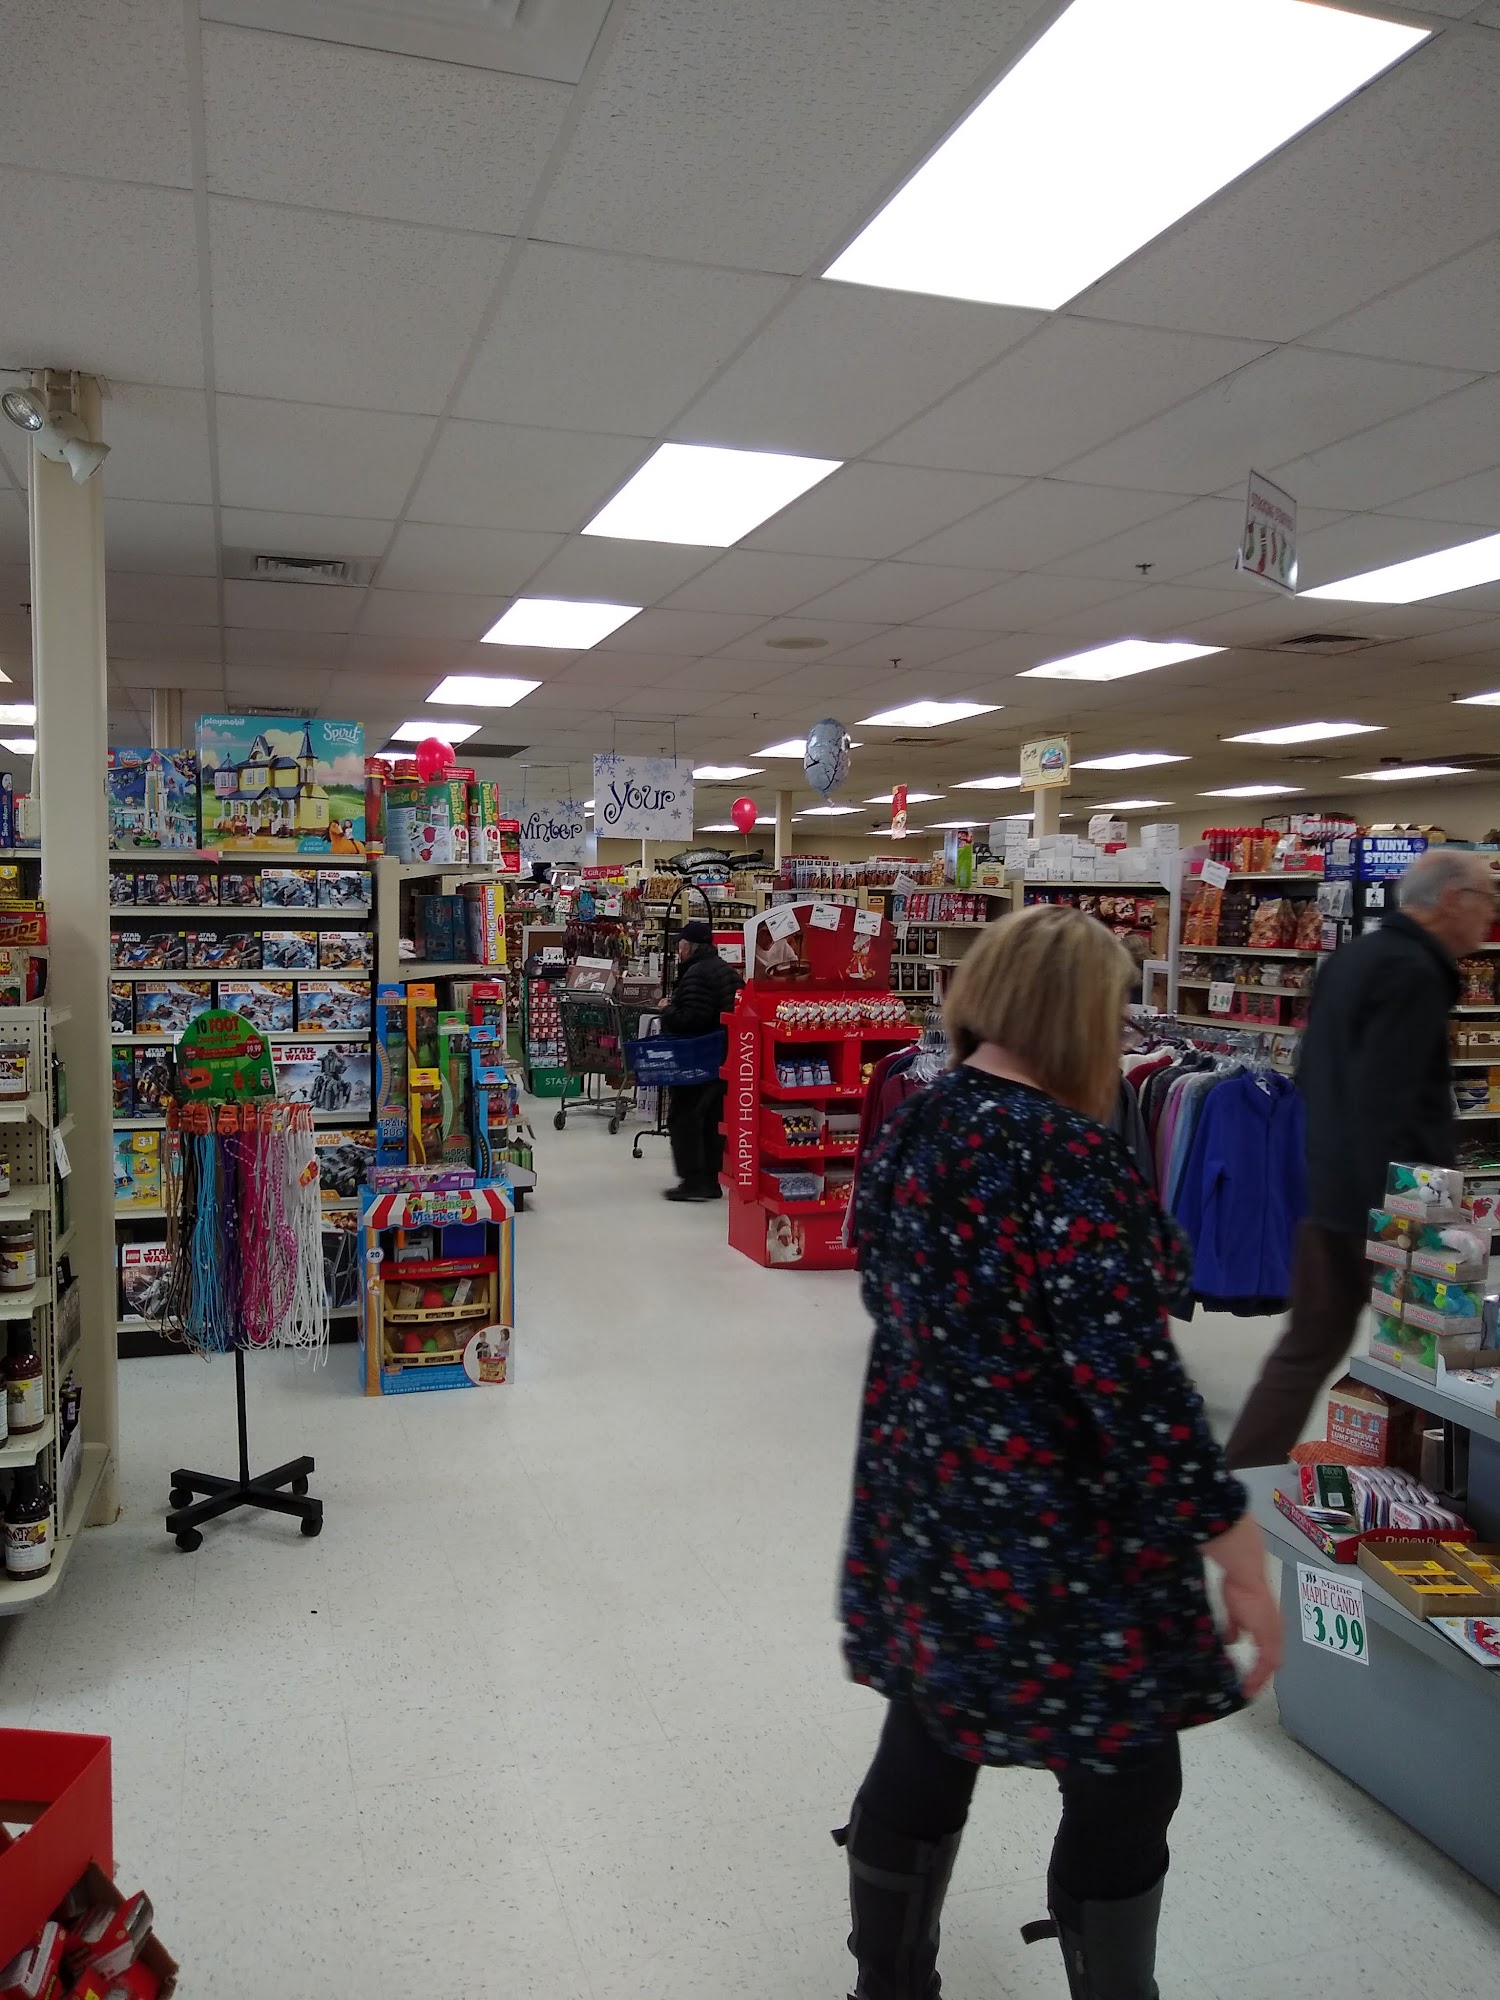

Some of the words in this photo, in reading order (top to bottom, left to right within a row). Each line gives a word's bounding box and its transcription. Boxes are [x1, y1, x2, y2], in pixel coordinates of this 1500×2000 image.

[204, 717, 245, 726] playmobil
[323, 722, 361, 744] Spirit
[450, 783, 459, 807] Pasta
[482, 783, 491, 807] Pasta
[1376, 839, 1411, 851] VINYL
[587, 868, 599, 877] Gift
[487, 888, 495, 920] Baking
[488, 922, 497, 943] Play
[489, 944, 498, 961] Set
[195, 1019, 208, 1034] 10
[209, 1016, 239, 1033] FOOT
[285, 1053, 316, 1061] WARS
[739, 1032, 754, 1120] HOLIDAYS
[377, 1118, 407, 1128] TRAIN
[383, 1128, 404, 1137] RUG
[739, 1127, 752, 1185] HAPPY
[425, 1199, 476, 1212] Farmers
[411, 1210, 461, 1223] Market
[1331, 1424, 1345, 1433] YOU
[1346, 1428, 1373, 1442] DESERVE
[1331, 1431, 1349, 1441] LUMP
[1350, 1437, 1359, 1445] OF
[1360, 1440, 1379, 1451] COAL
[1321, 1580, 1352, 1596] Maine
[1302, 1583, 1329, 1607] MAPLE
[1330, 1592, 1361, 1618] CANDY
[1304, 1603, 1364, 1656] $3.99
